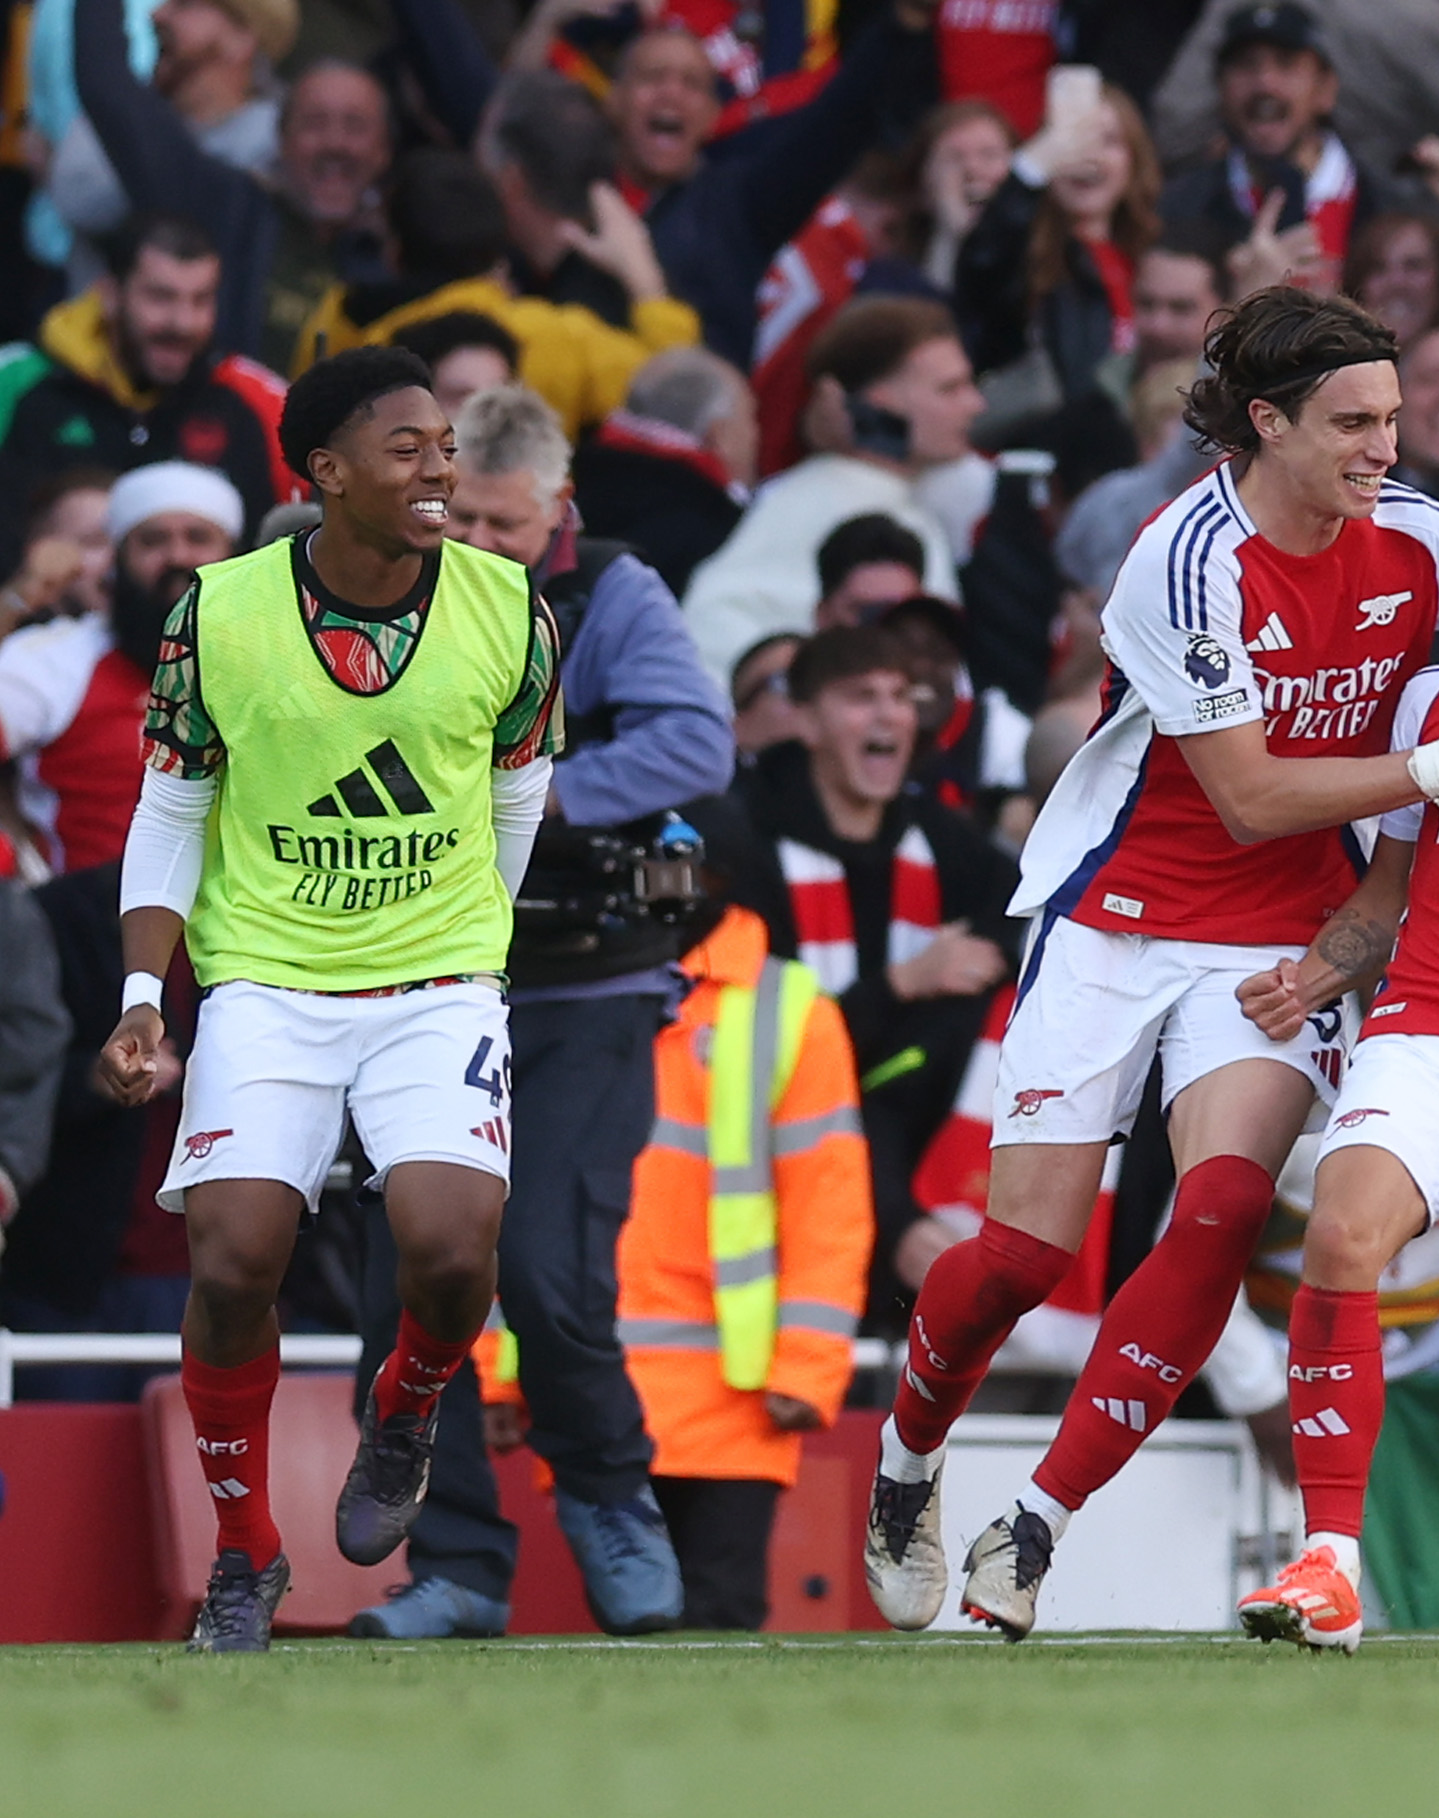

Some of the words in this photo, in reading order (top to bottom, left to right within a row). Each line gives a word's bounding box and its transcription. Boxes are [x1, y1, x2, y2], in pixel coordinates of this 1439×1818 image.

[267, 824, 460, 869] Emirates
[292, 873, 337, 907] FLY
[342, 869, 432, 910] BETTER
[1119, 1342, 1183, 1383] AFC
[1289, 1363, 1353, 1383] AFC
[196, 1436, 248, 1456] AFC
